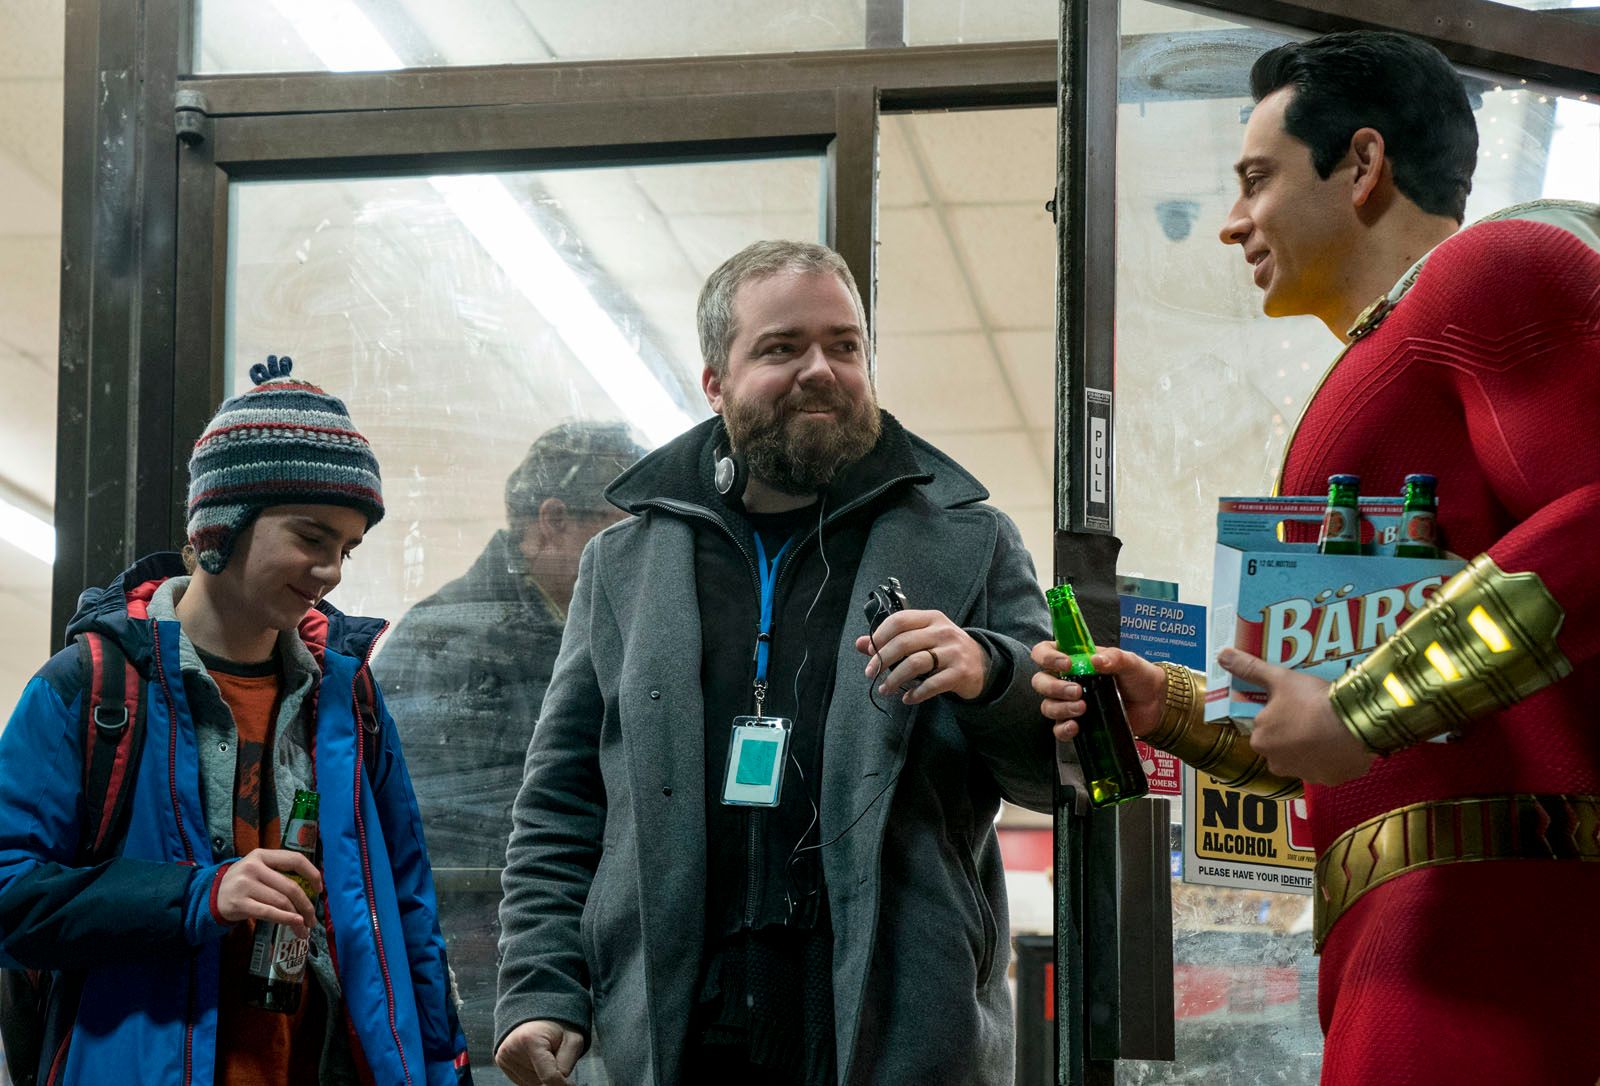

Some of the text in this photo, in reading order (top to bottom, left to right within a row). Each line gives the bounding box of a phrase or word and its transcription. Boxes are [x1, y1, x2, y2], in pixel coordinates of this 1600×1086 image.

[1248, 559, 1257, 575] 6
[1135, 603, 1184, 620] PRE-PAID
[1120, 616, 1196, 636] PHONE CARDS
[1158, 759, 1174, 768] TIME
[1157, 768, 1175, 777] LIMIT
[1202, 788, 1278, 834] NO
[1202, 832, 1277, 859] ALCOHOL
[1199, 866, 1230, 878] PLEASE
[1232, 870, 1254, 880] HAVE
[1256, 872, 1279, 883] YOUR
